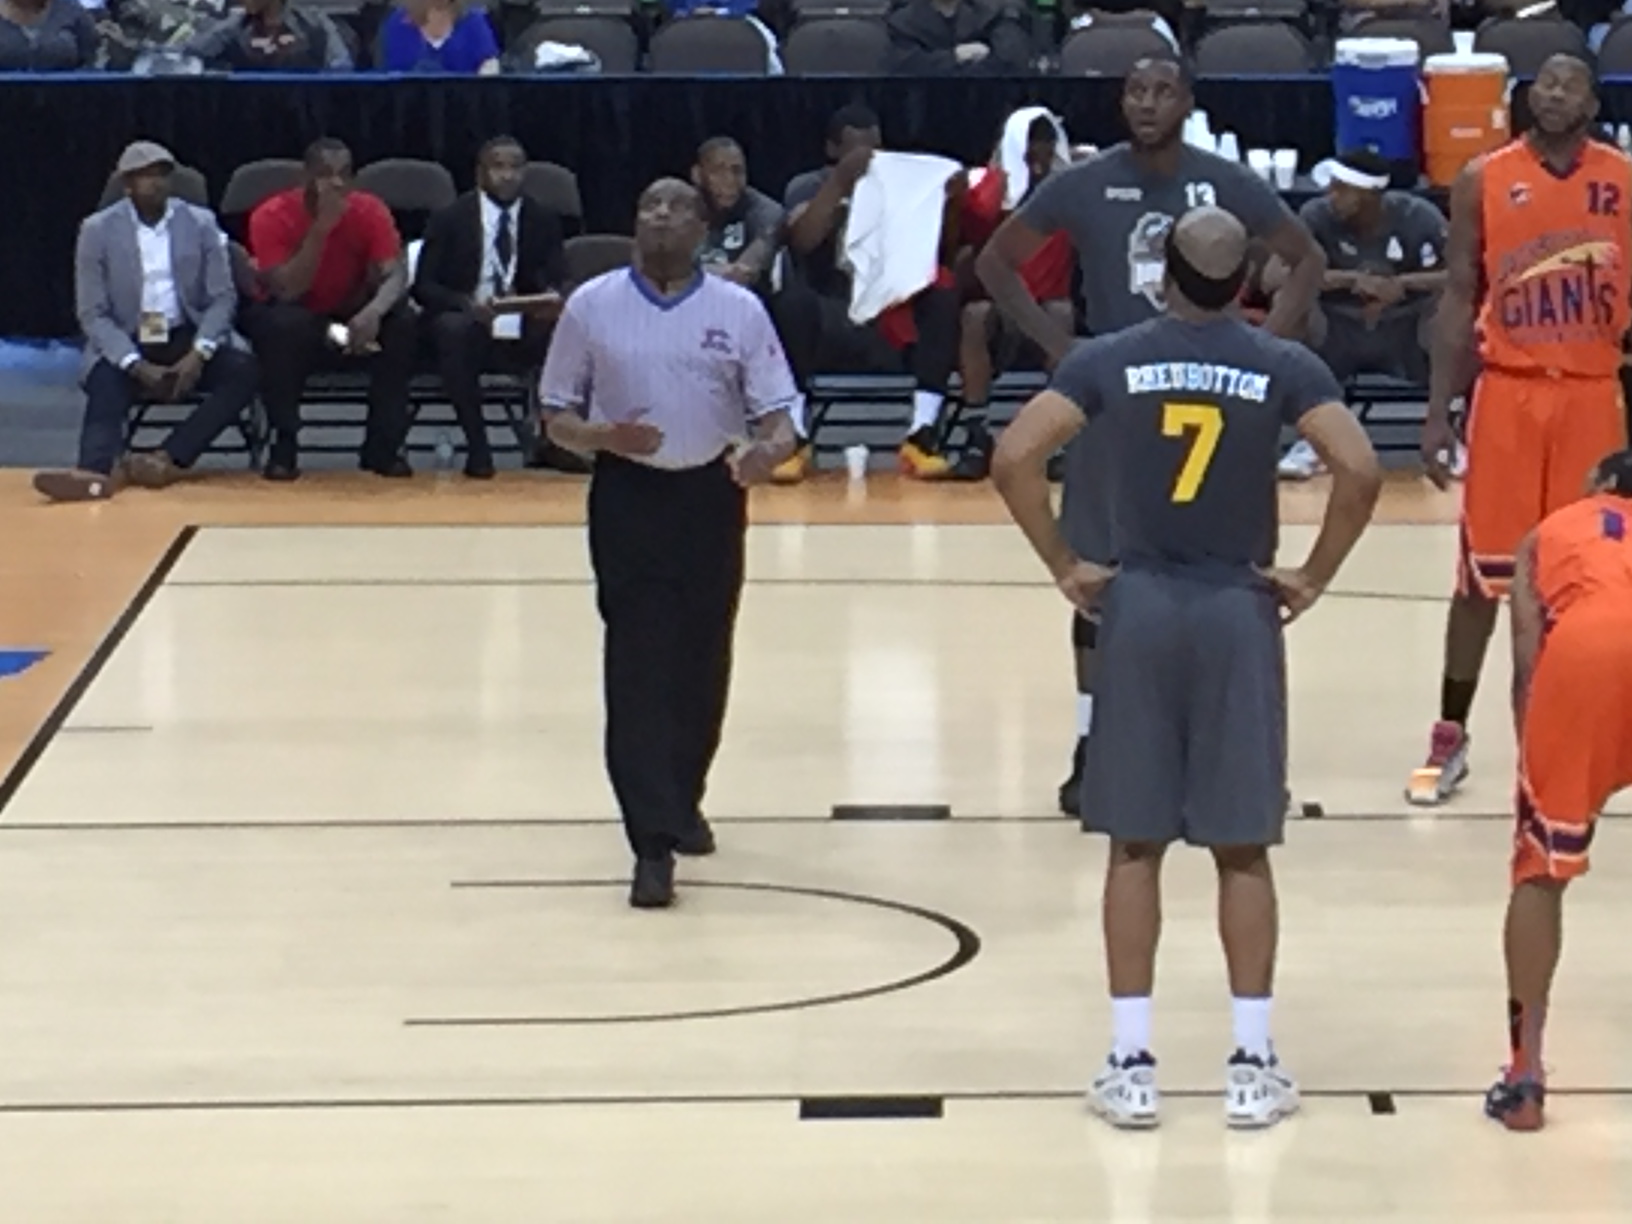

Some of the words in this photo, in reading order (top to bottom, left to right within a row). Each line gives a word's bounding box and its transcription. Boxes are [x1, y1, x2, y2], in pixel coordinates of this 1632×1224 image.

[1587, 182, 1620, 216] 12
[1502, 272, 1619, 328] GIANTS
[1162, 403, 1224, 502] 7
